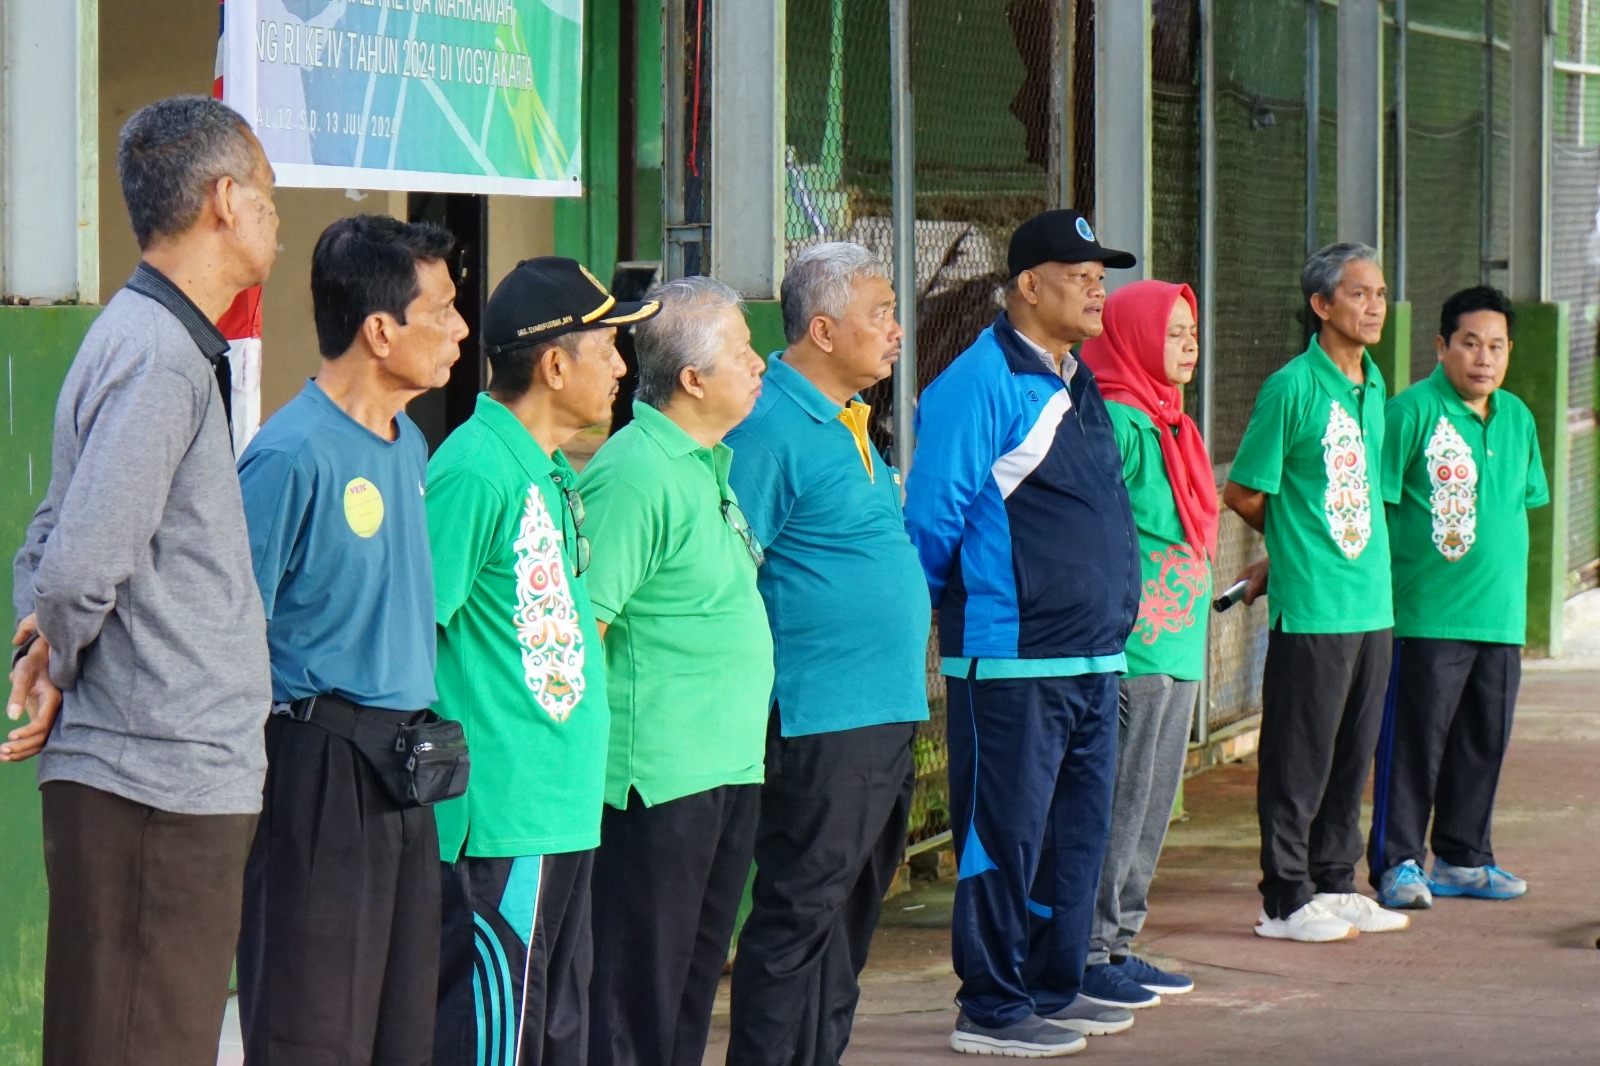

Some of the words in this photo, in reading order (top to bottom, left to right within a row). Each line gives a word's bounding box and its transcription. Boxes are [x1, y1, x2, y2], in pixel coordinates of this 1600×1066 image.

[284, 22, 300, 65] RI
[305, 25, 322, 67] KE
[328, 28, 343, 69] IV
[347, 31, 398, 75] TAHUN
[403, 39, 436, 80] 2024
[441, 43, 452, 81] DI
[456, 46, 533, 92] YOGYAKARTA
[278, 108, 292, 130] 12
[326, 112, 338, 133] 13
